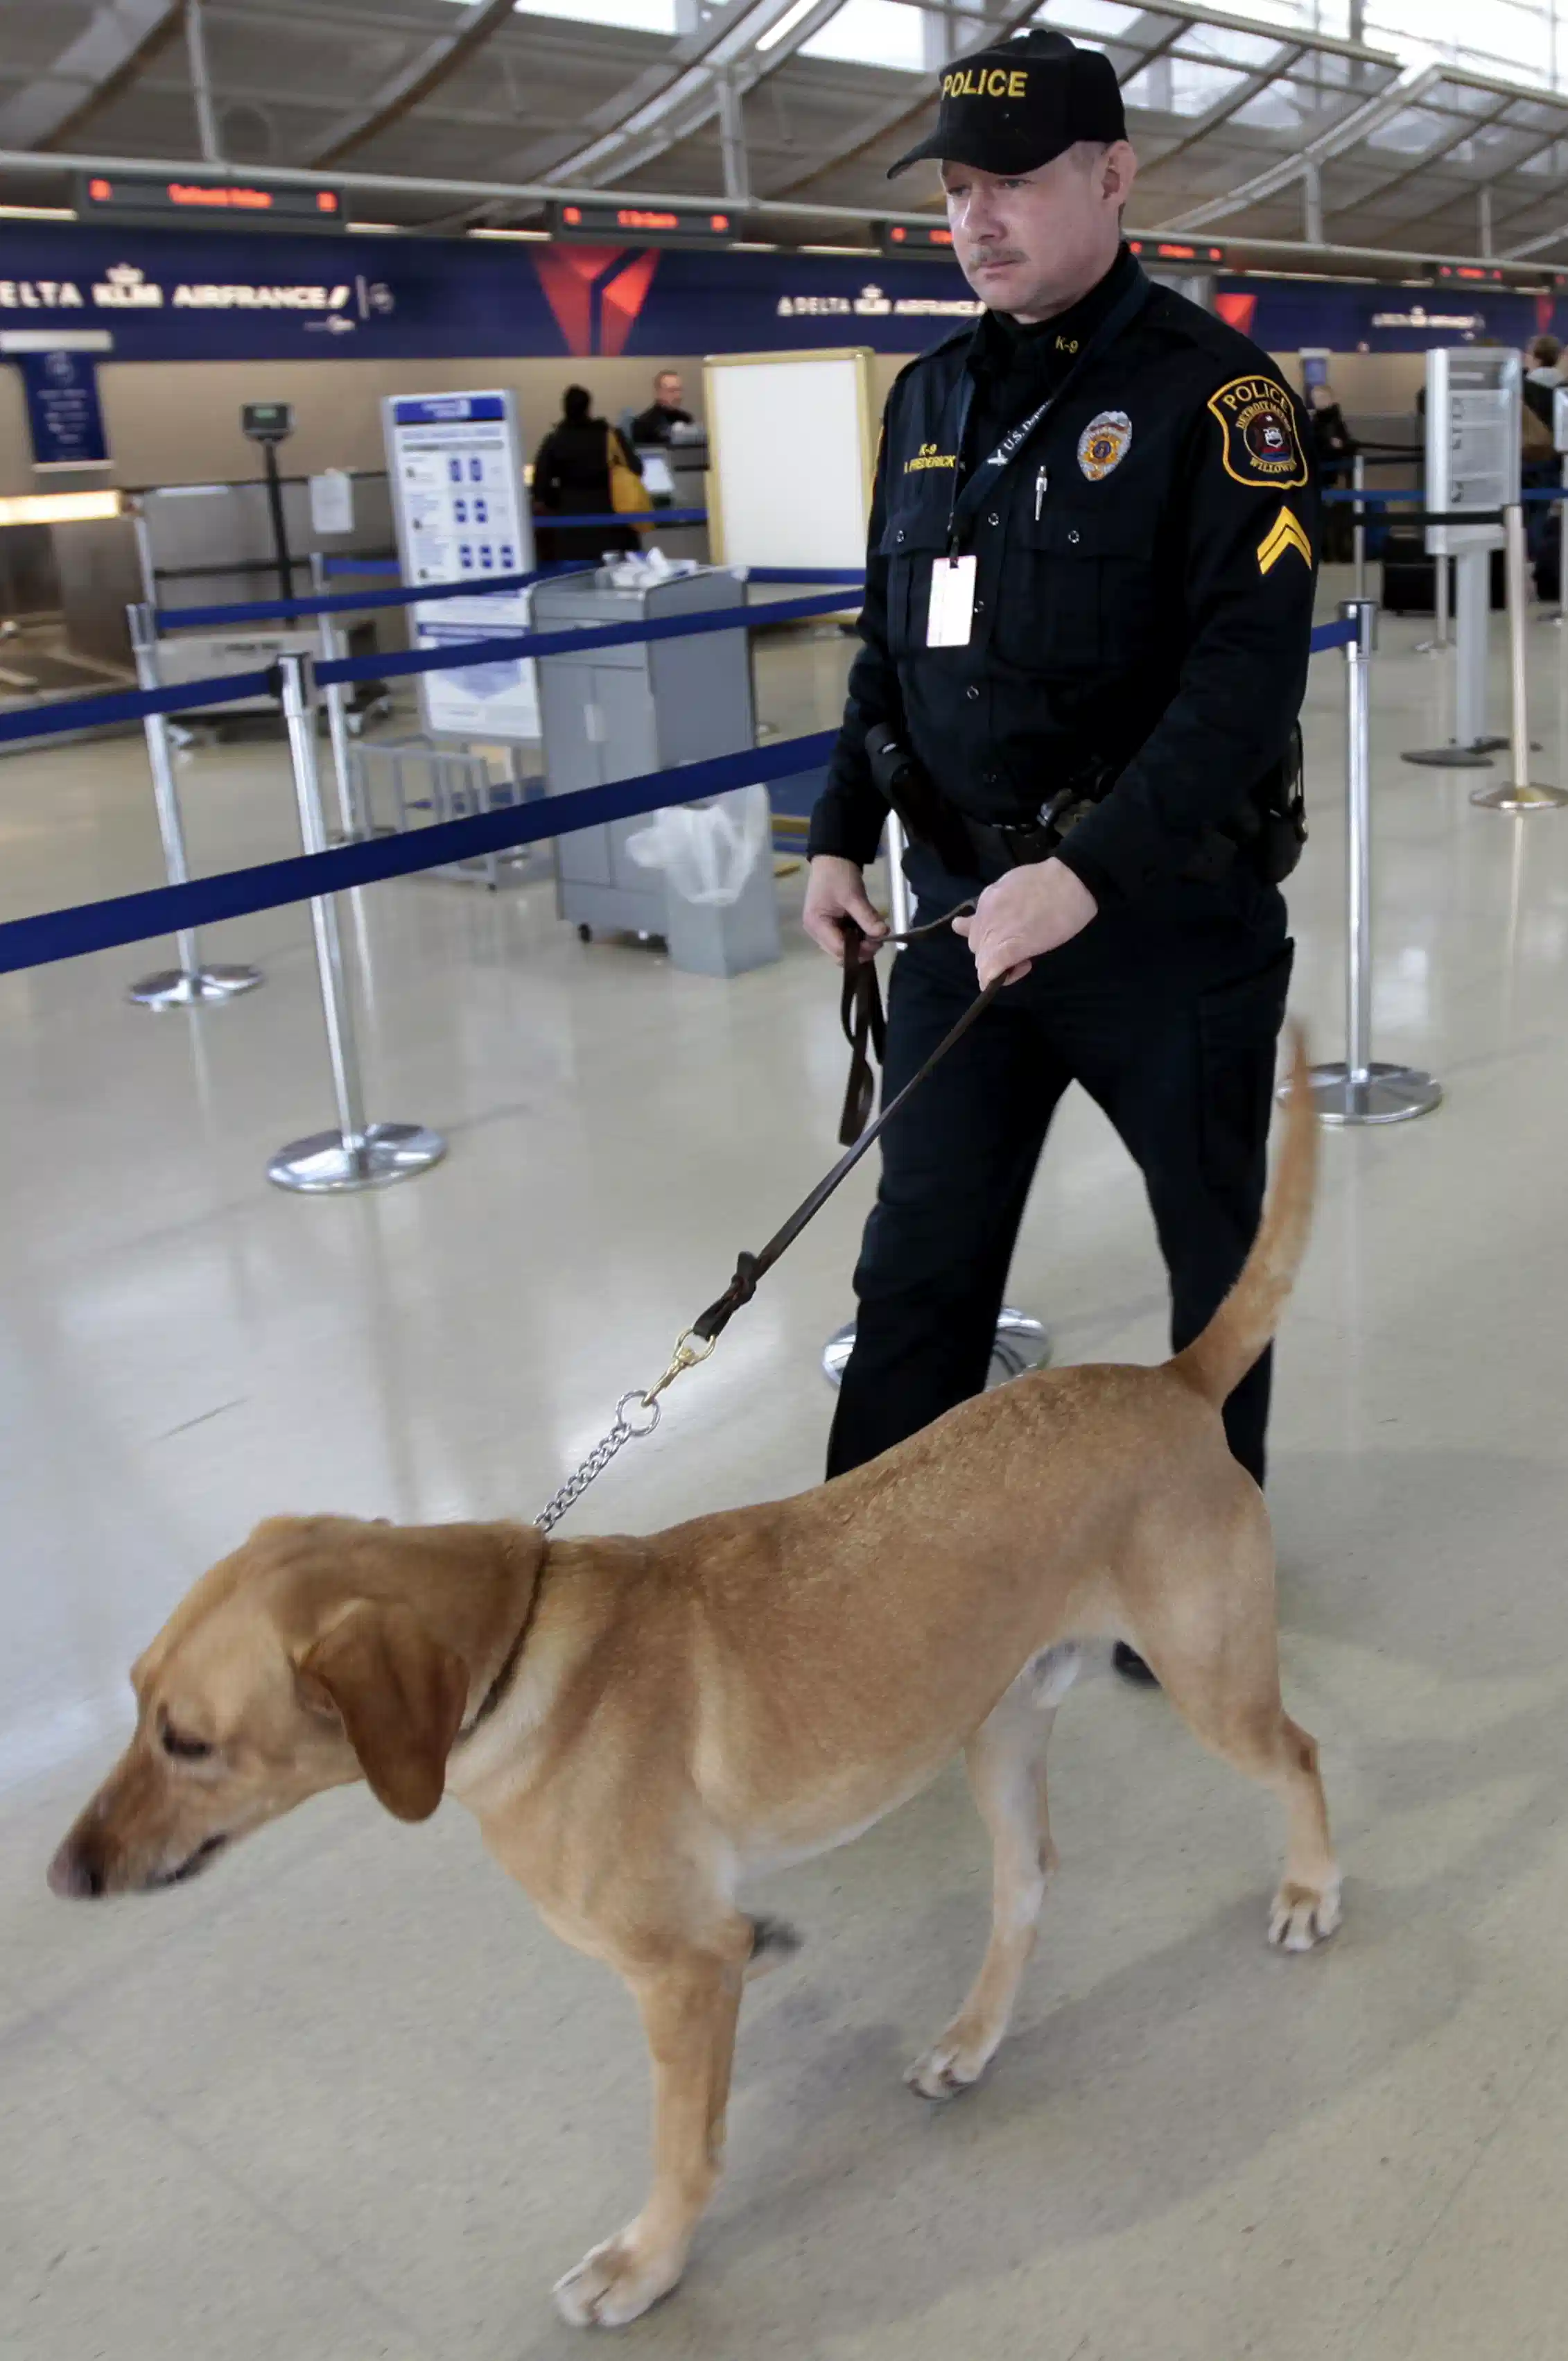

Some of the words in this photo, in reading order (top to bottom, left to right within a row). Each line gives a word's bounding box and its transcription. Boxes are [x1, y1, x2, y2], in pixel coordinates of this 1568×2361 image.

[941, 68, 1029, 100] POLICE
[0, 280, 85, 308] ELTA
[1055, 335, 1079, 354] K-9
[1222, 382, 1287, 413] POLICE
[918, 442, 938, 456] K-9
